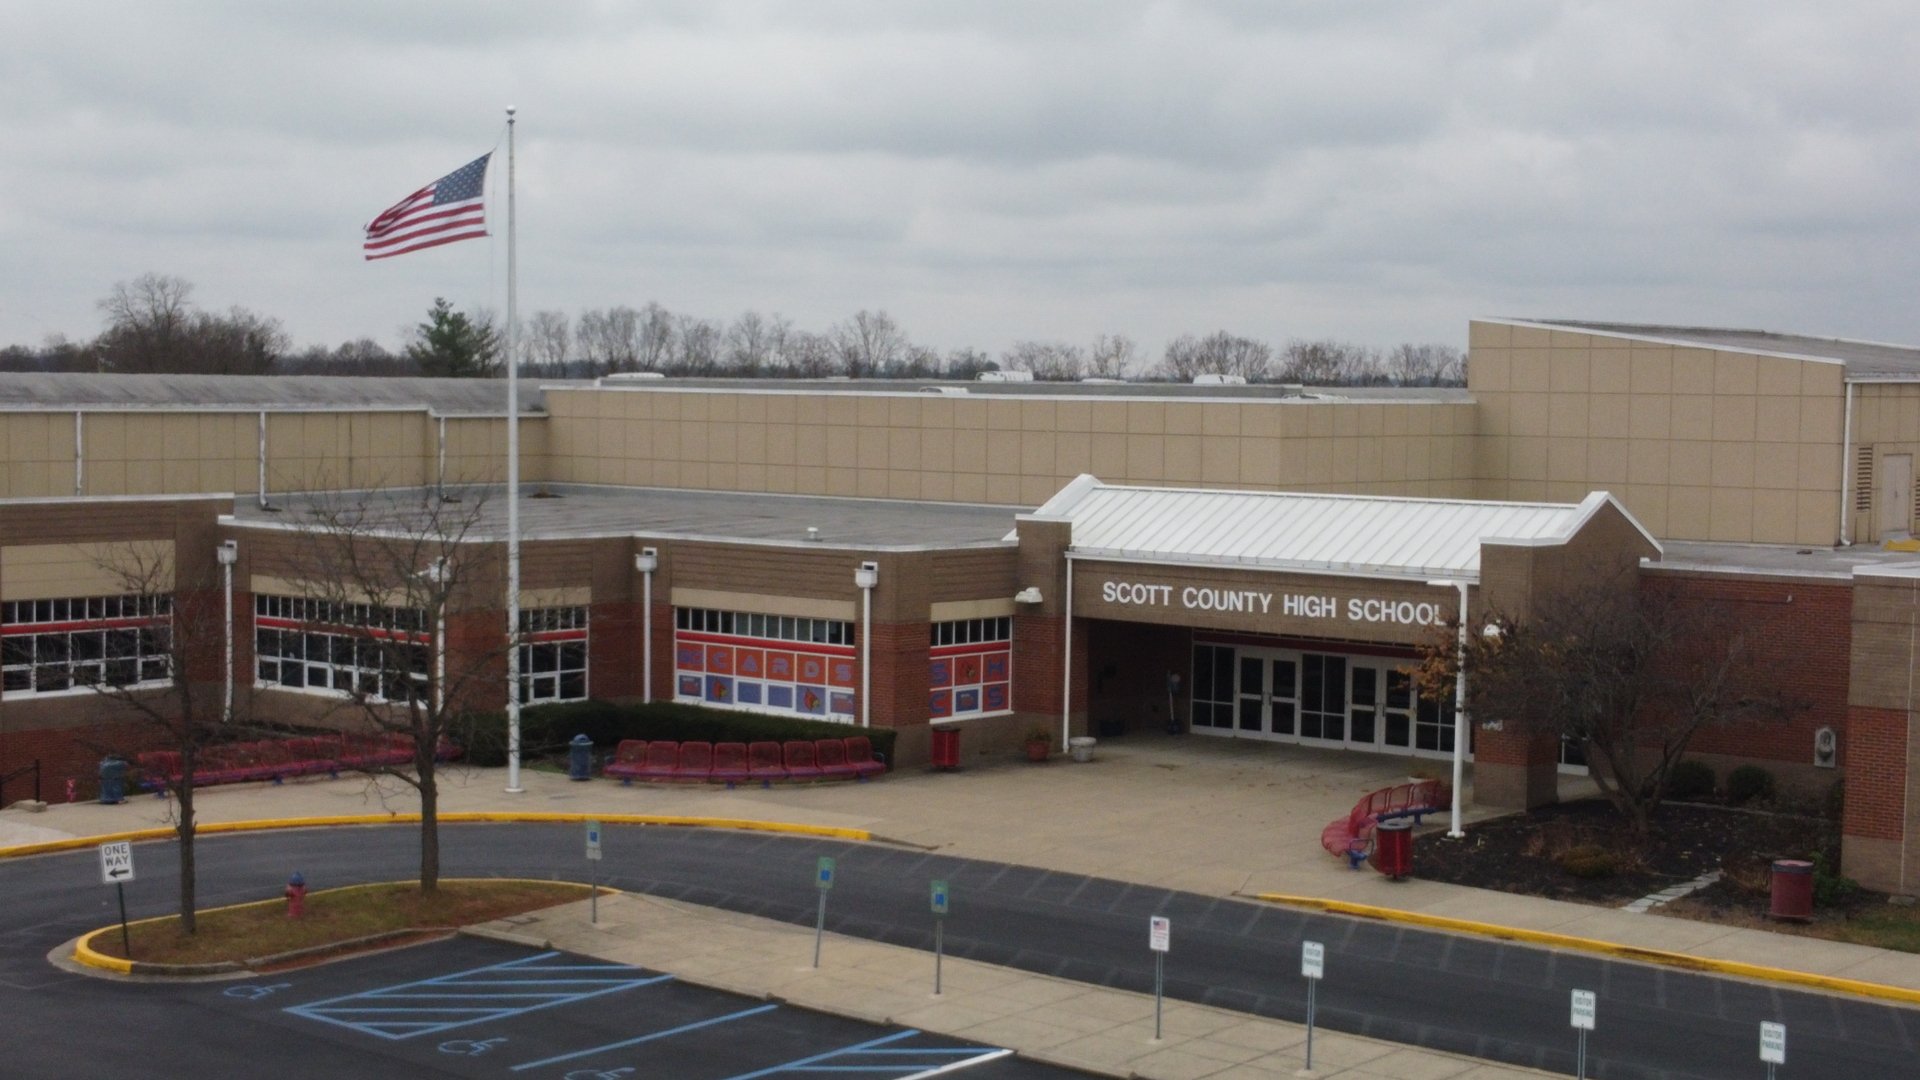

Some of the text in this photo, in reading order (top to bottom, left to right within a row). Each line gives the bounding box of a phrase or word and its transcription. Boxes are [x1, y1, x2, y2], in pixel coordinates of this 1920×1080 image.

[1102, 581, 1447, 626] SCOTT COUNTY HIGH SCHOOL
[711, 651, 852, 682] CARDS
[104, 844, 128, 856] ONE
[105, 855, 129, 867] WAY
